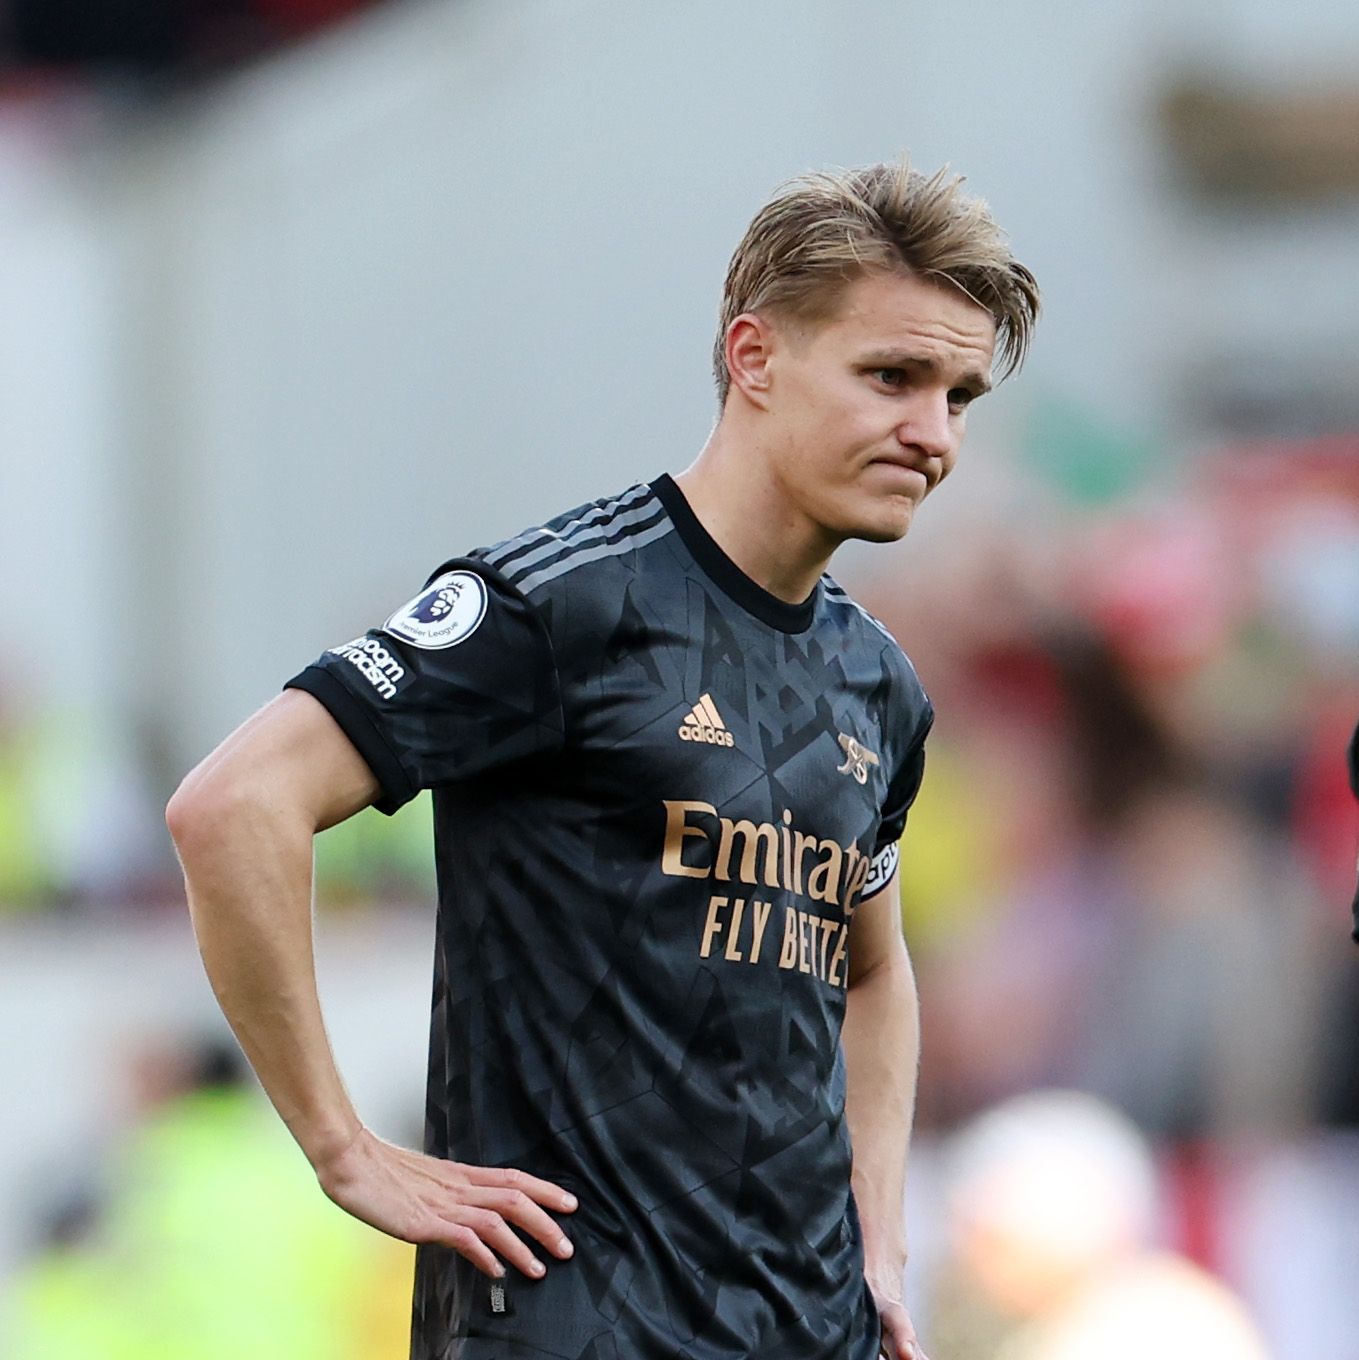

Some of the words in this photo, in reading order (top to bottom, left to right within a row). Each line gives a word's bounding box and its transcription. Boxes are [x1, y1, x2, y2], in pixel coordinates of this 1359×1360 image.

[428, 621, 458, 637] League
[678, 724, 735, 748] adidas
[661, 799, 871, 916] Emirate
[699, 895, 772, 965] FLY
[778, 905, 848, 990] BETTE
